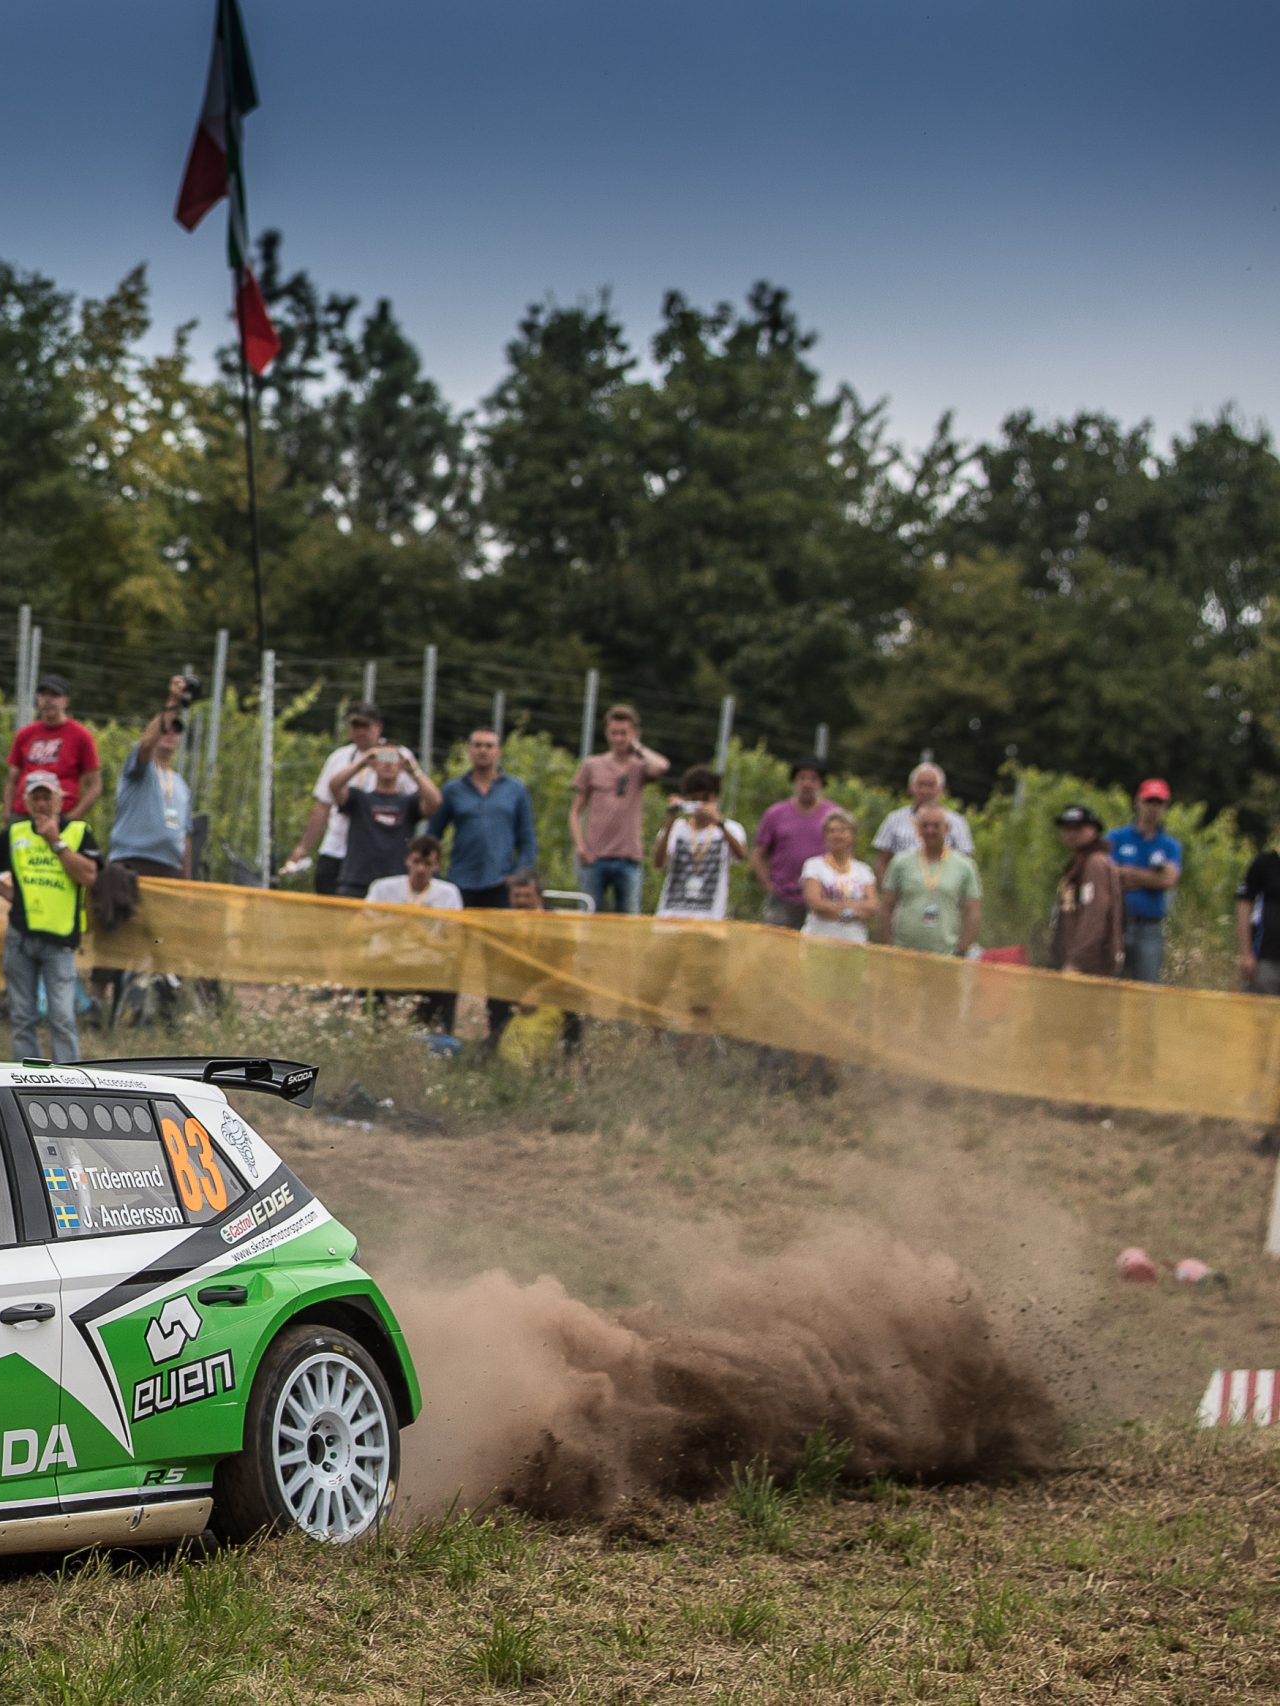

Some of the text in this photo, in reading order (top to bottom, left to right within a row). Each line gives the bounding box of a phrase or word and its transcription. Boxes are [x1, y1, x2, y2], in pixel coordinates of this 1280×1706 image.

[11, 1073, 61, 1084] ŠKODA
[160, 1117, 227, 1212] 83
[85, 1165, 164, 1190] Tidemand
[101, 1205, 184, 1228] Andersson
[228, 1181, 295, 1238] Castrol EDGE
